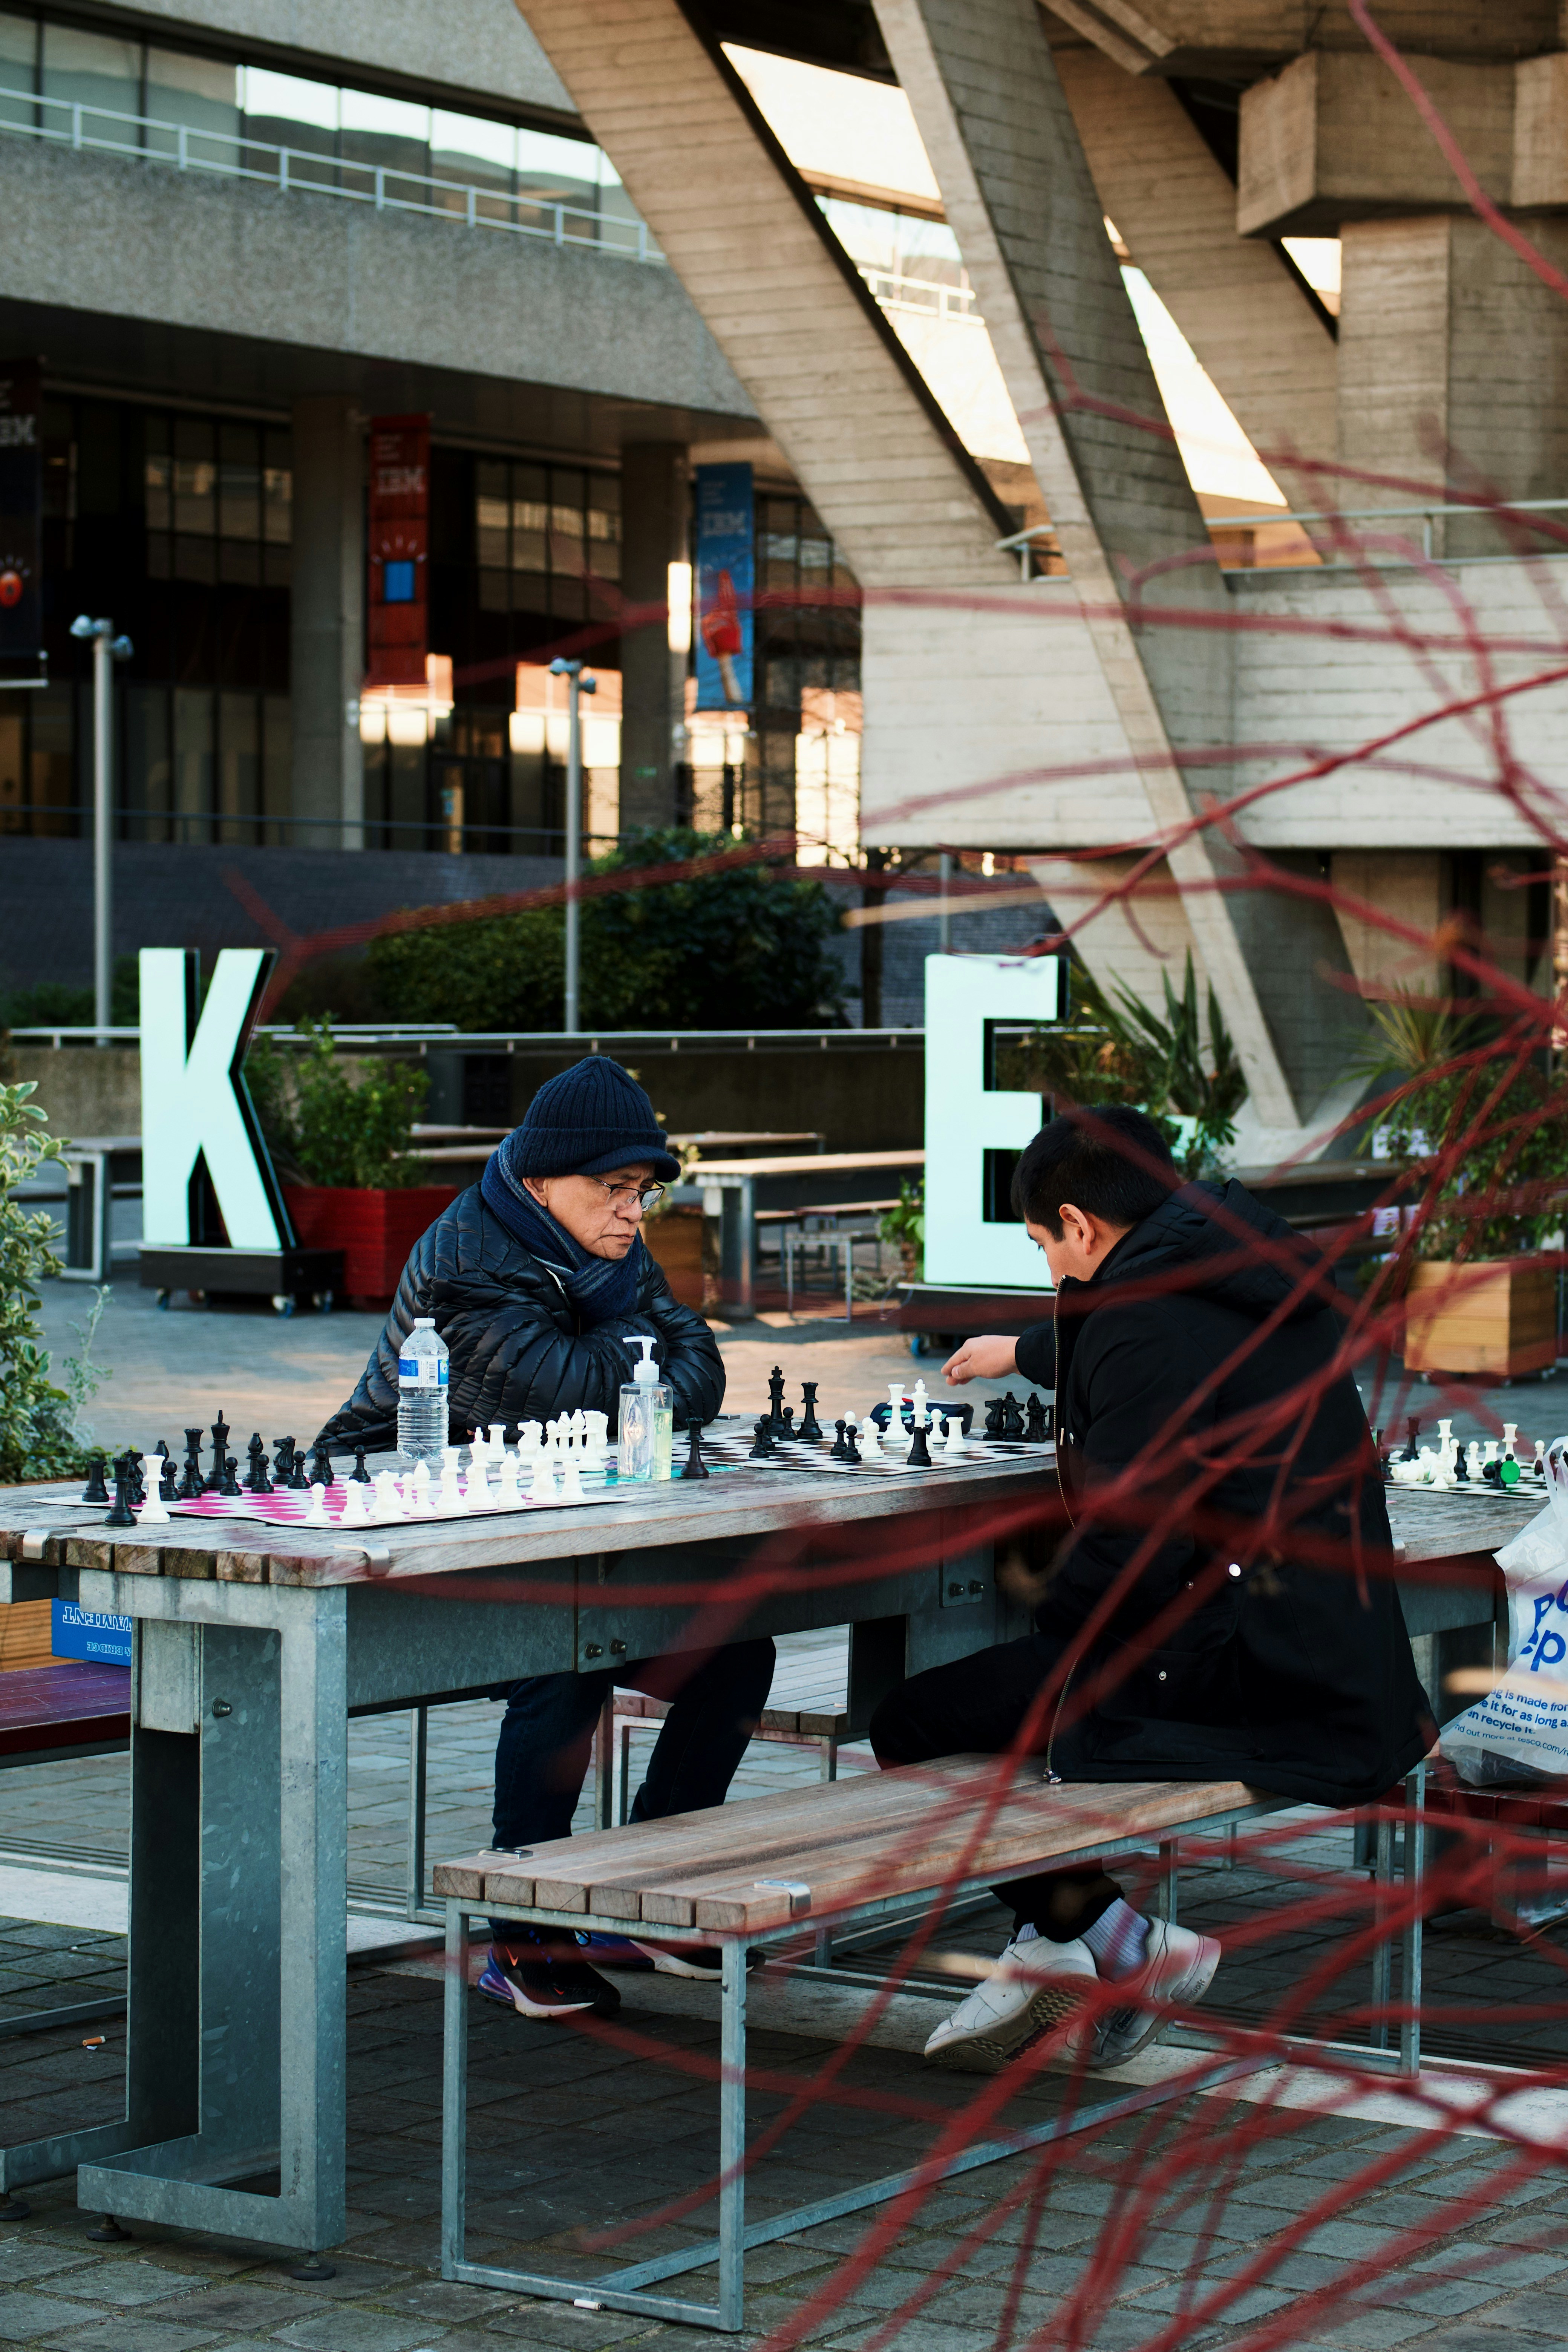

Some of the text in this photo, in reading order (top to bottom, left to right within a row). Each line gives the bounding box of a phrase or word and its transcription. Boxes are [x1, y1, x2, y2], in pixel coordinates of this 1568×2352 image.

[139, 947, 282, 1250] K
[925, 954, 1059, 1288] E
[87, 1642, 123, 1656] BRIDGE
[1505, 1689, 1514, 1700] is
[1517, 1694, 1548, 1710] made
[1479, 1700, 1488, 1708] e
[1490, 1700, 1499, 1711] it
[1501, 1704, 1518, 1717] for
[1520, 1712, 1533, 1721] as
[1535, 1714, 1557, 1729] long
[1481, 1715, 1522, 1732] recycle
[1518, 1737, 1568, 1757] tesco.com/r
[1183, 1978, 1205, 2003] Reebok
